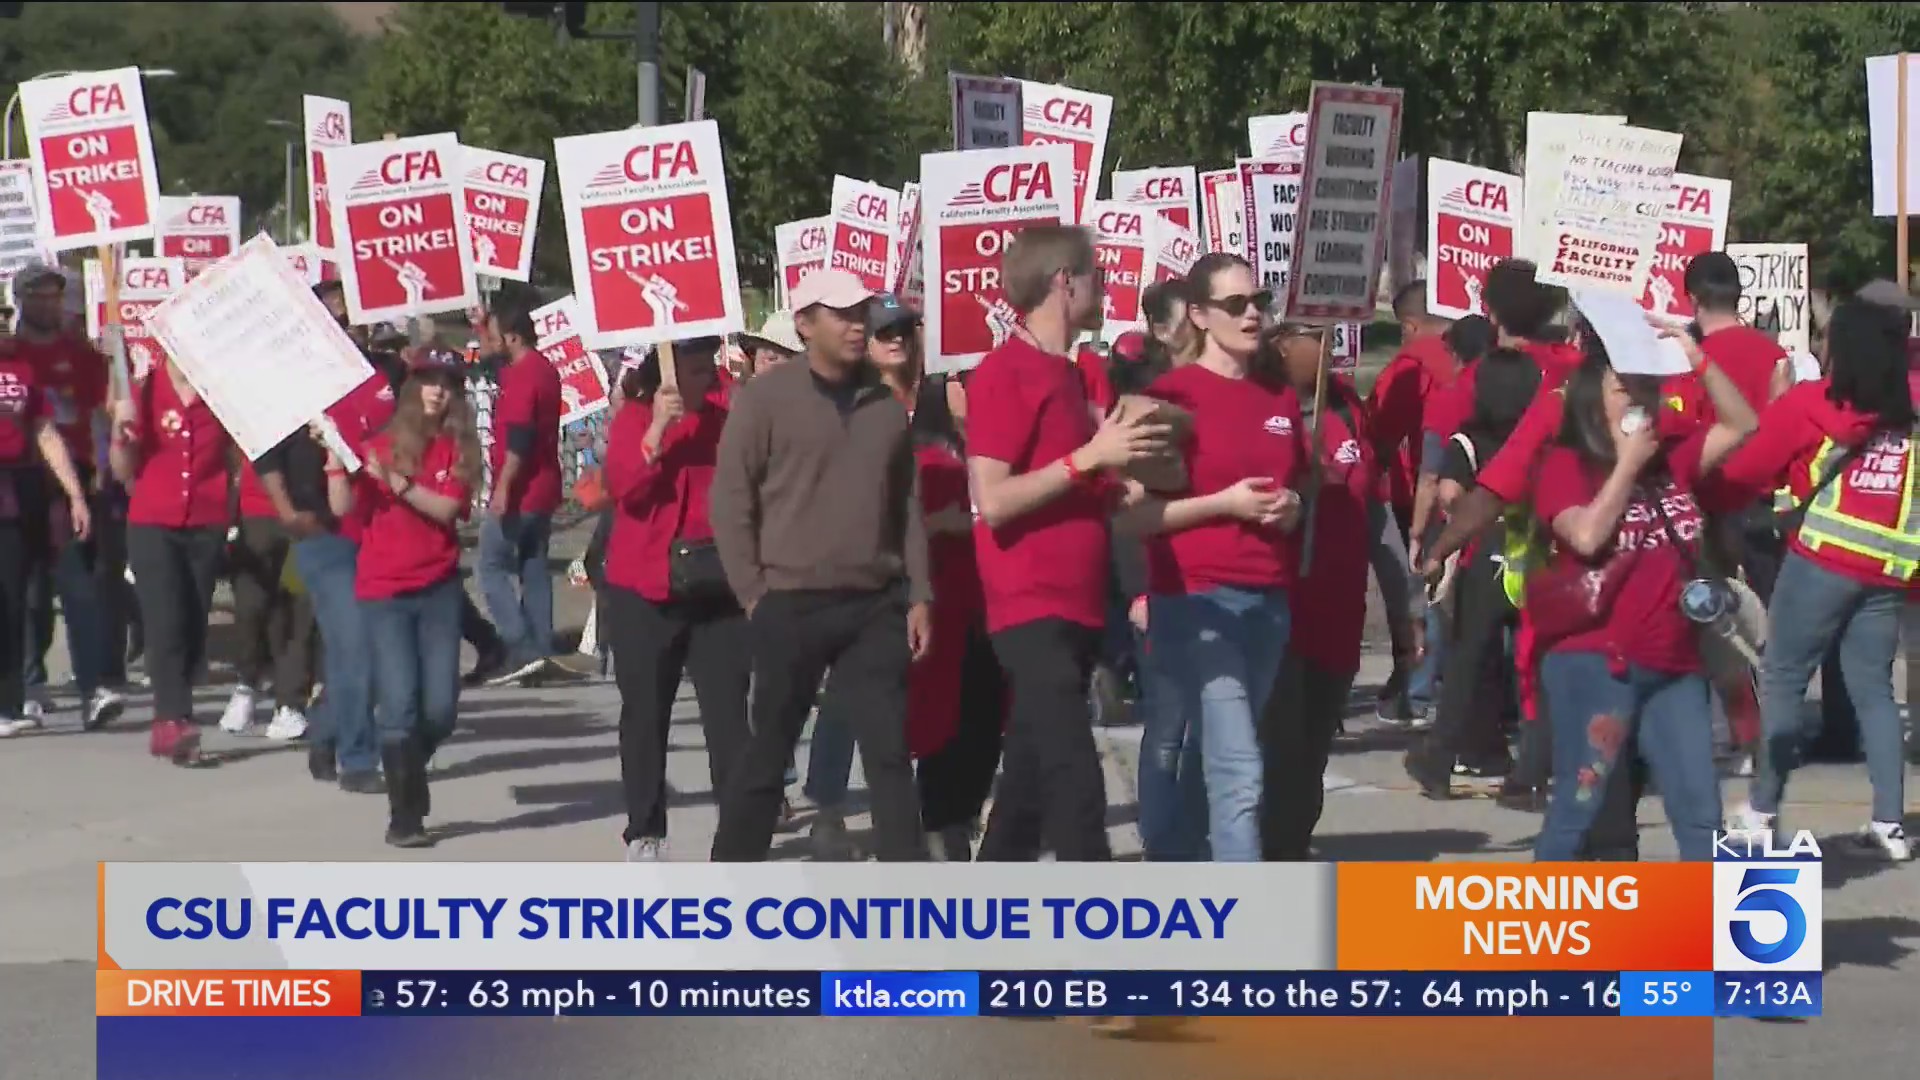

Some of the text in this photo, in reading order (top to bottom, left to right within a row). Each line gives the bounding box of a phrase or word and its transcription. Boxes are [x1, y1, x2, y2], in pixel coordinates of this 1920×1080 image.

[69, 83, 126, 116] CFA
[1043, 98, 1093, 130] CFA
[68, 135, 108, 160] ON
[49, 159, 139, 189] STRIKE!
[381, 150, 442, 185] CFA
[623, 140, 698, 182] CFA
[486, 162, 528, 188] CFA
[983, 161, 1053, 203] CFA
[1145, 177, 1184, 200] CFA
[1465, 180, 1508, 212] CFA
[188, 205, 226, 225] CFA
[379, 202, 424, 227] ON
[474, 194, 506, 214] ON
[620, 203, 675, 231] ON
[857, 194, 887, 221] CFA
[1098, 211, 1142, 236] CFA
[1459, 223, 1490, 246] ON
[355, 228, 454, 260] STRIKE!
[800, 227, 827, 251] CFA
[850, 232, 872, 252] ON
[591, 235, 713, 272] STRIKE!
[833, 251, 885, 276] STRIKE!
[127, 267, 169, 288] CFA
[1736, 295, 1804, 332] READY
